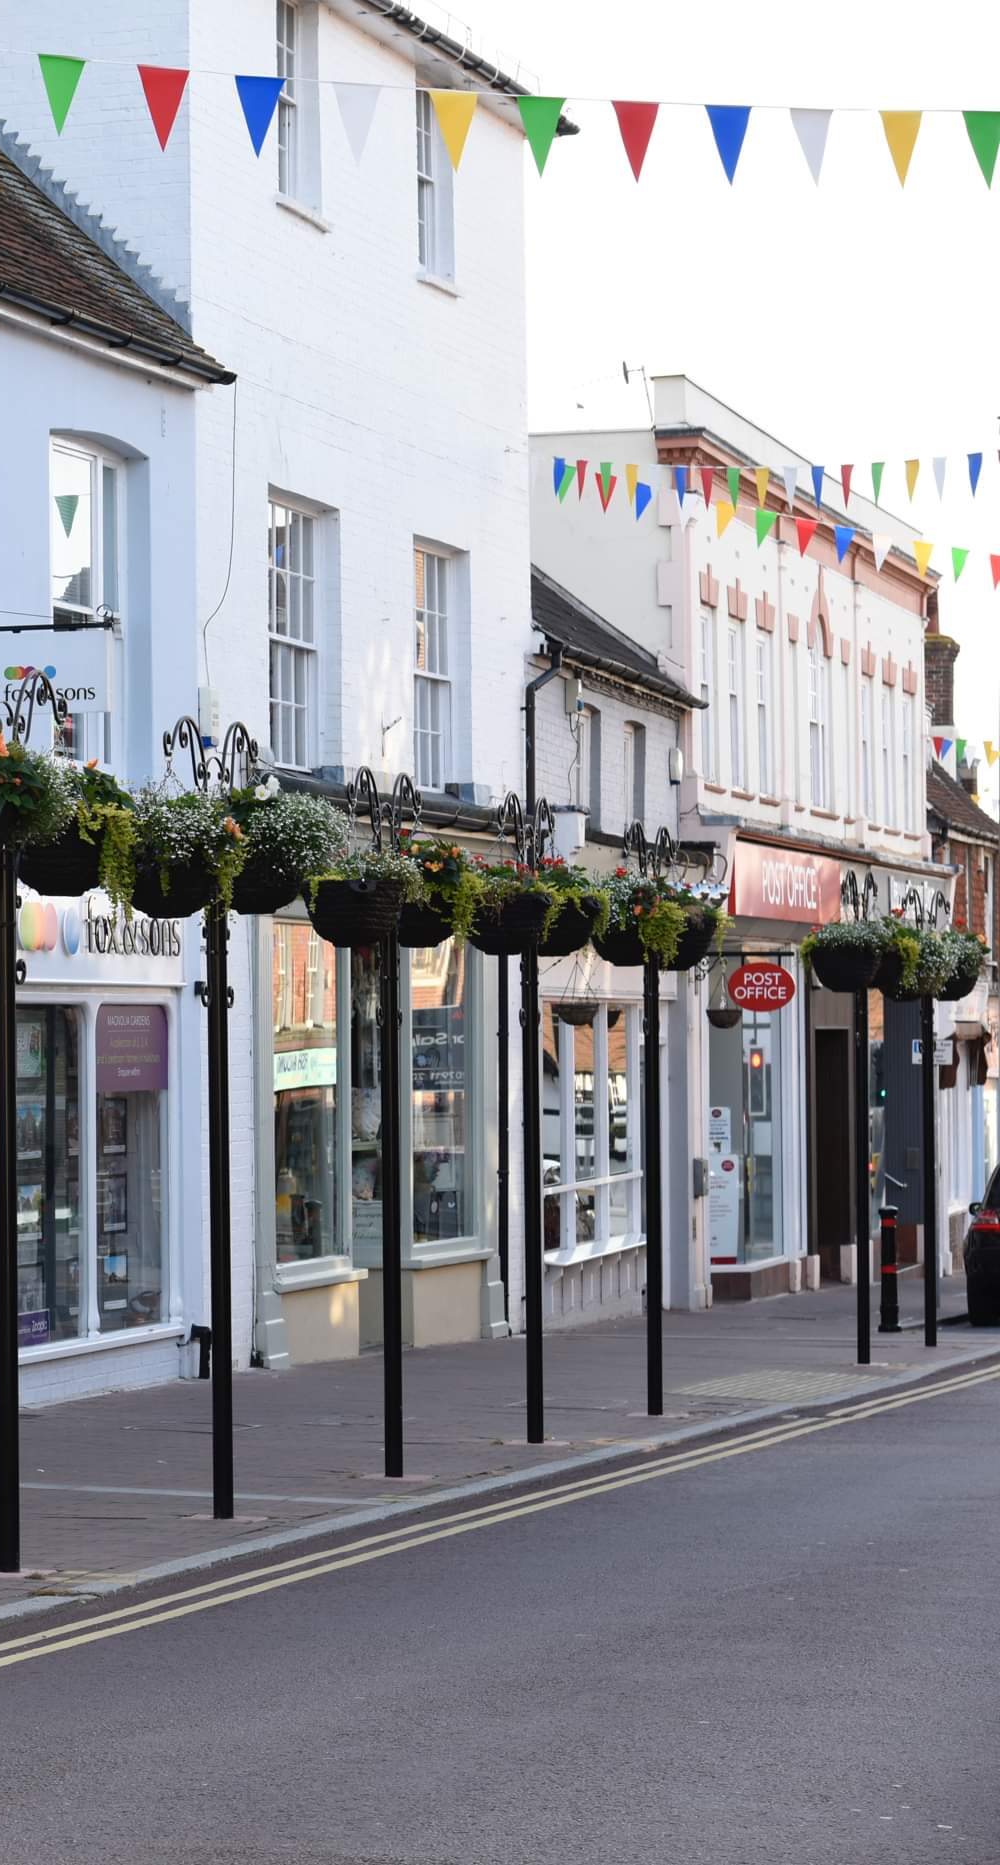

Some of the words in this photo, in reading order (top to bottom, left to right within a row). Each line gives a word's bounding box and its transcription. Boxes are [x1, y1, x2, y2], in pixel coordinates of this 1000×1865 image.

[55, 687, 96, 701] sons
[762, 861, 785, 905] POST
[786, 863, 817, 910] OFFICE
[140, 918, 181, 956] sons
[743, 972, 782, 986] POST
[734, 986, 787, 1000] OFFICE
